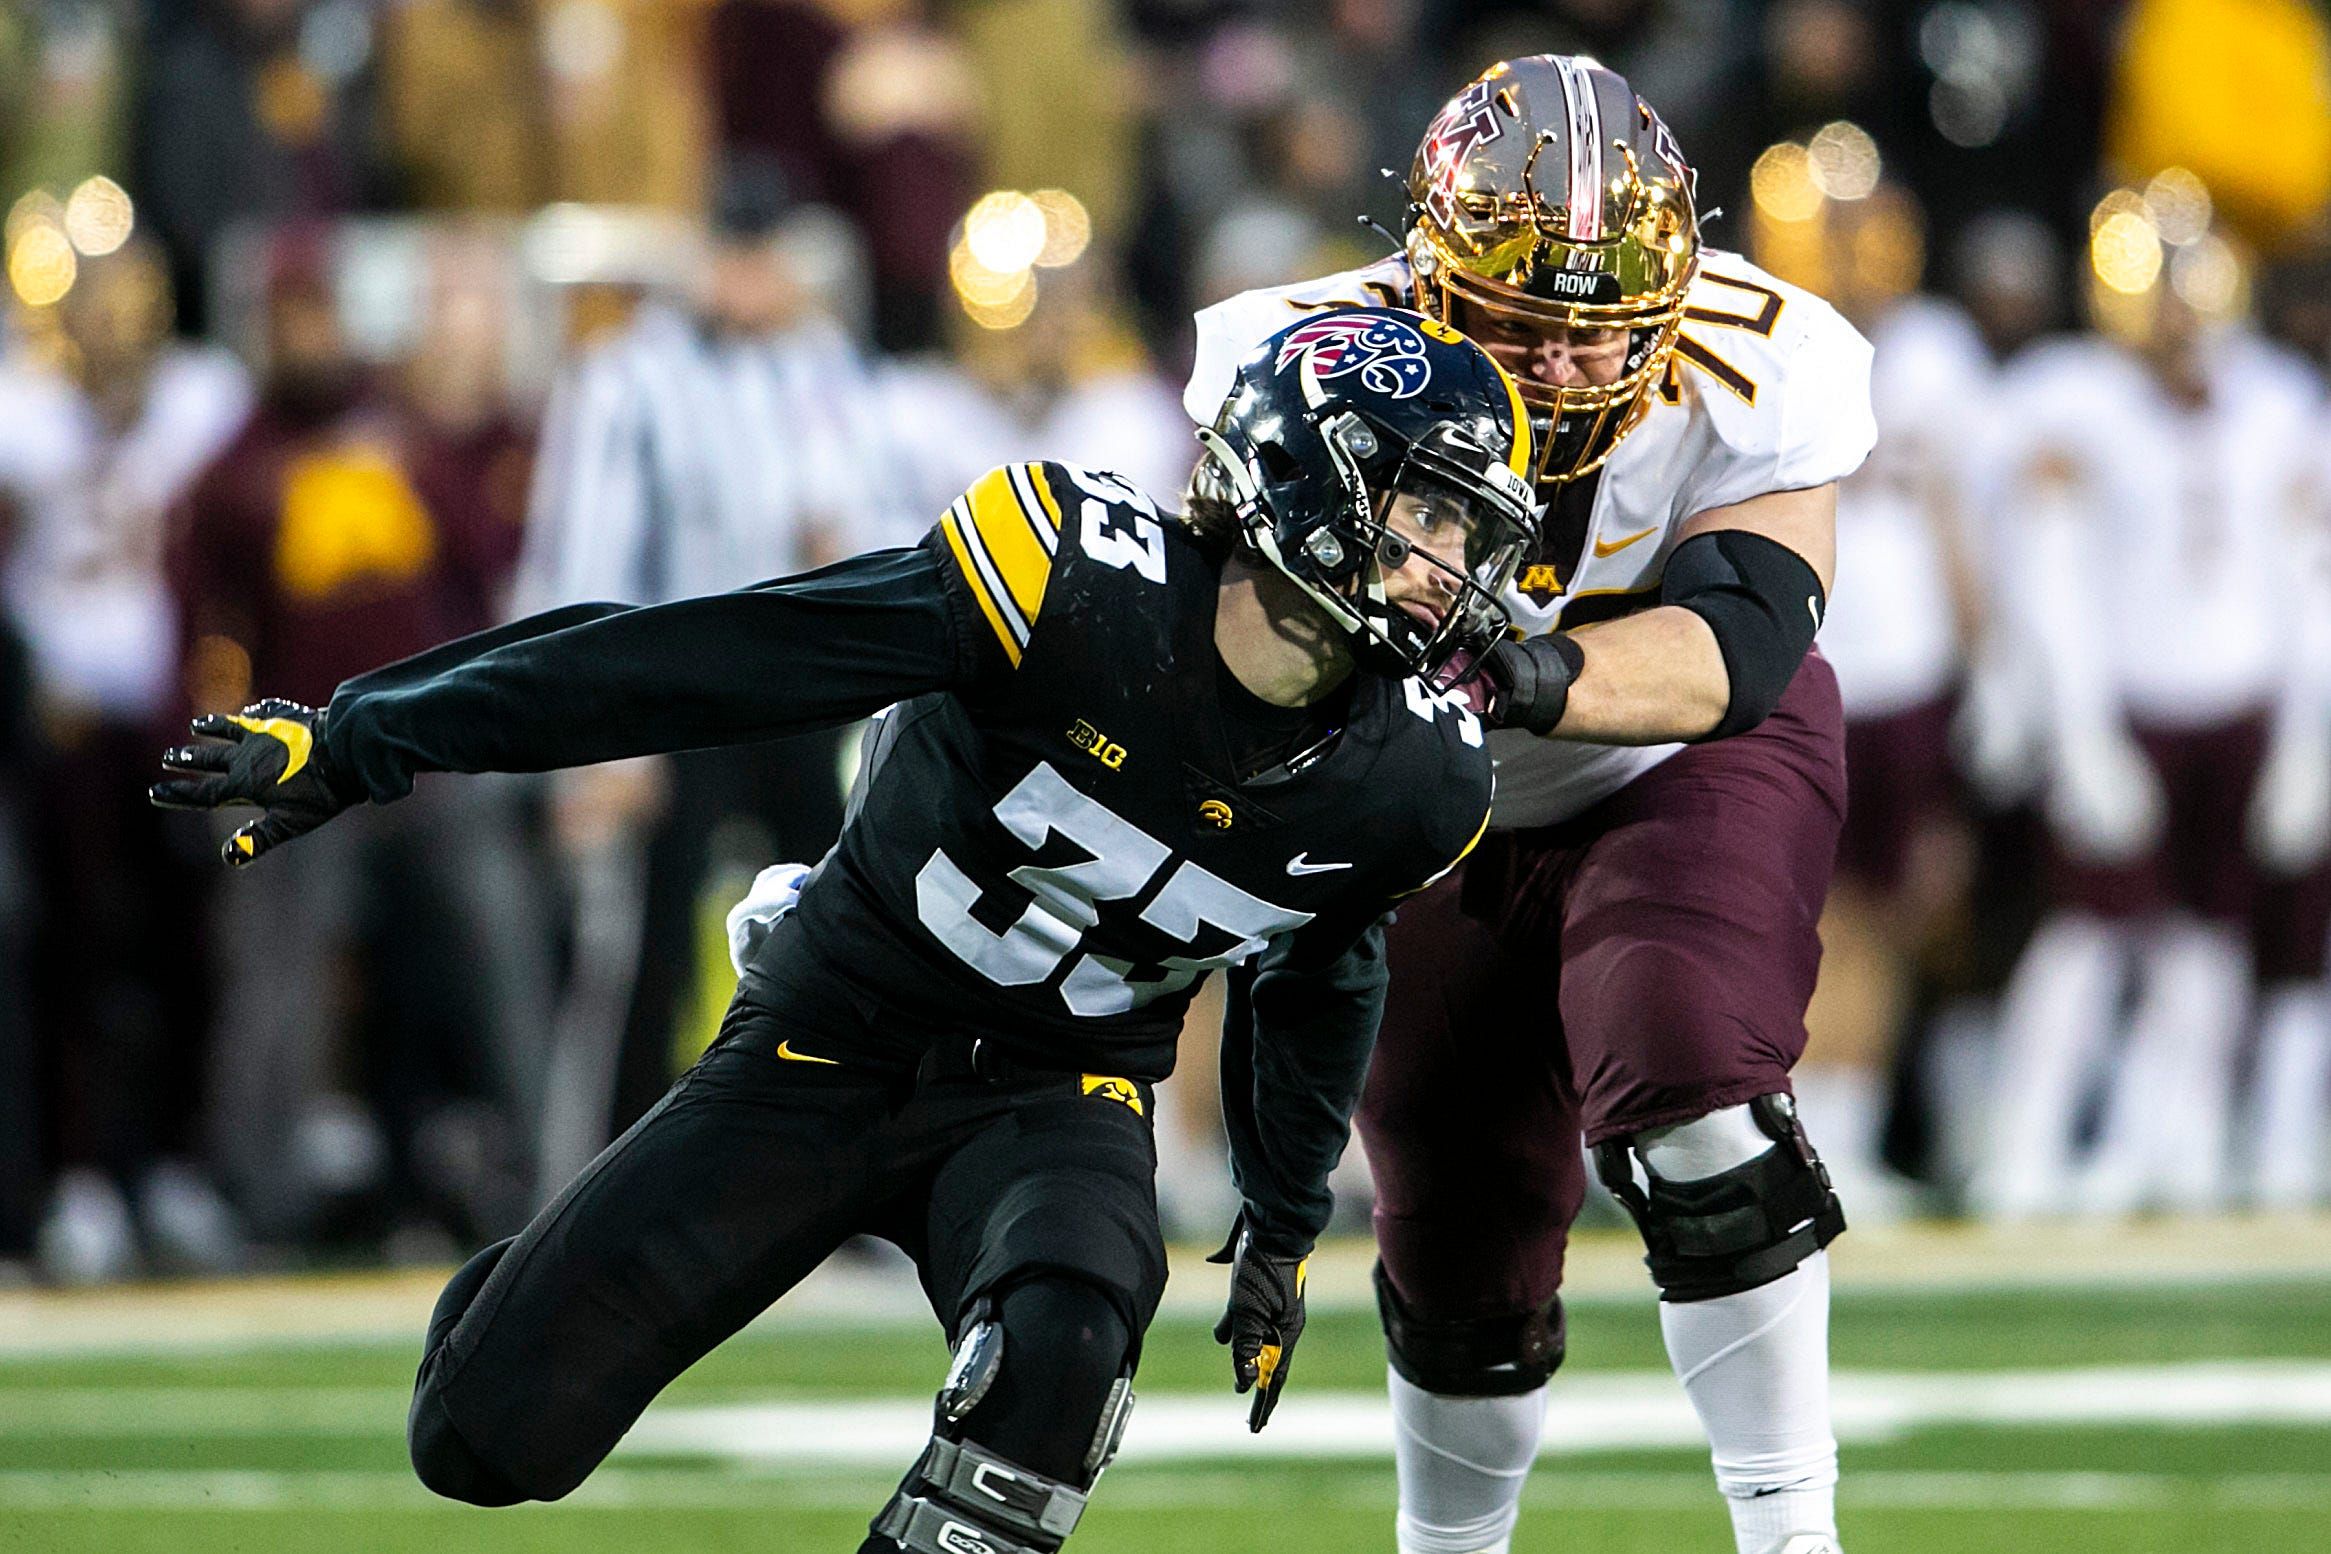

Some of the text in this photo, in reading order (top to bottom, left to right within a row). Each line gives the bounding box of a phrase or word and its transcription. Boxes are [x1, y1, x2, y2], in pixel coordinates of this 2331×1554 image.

[1553, 272, 1598, 295] ROW
[1655, 270, 1786, 408] 70
[1068, 463, 1168, 585] 33
[1518, 564, 1564, 593] M
[915, 760, 1317, 1018] 33
